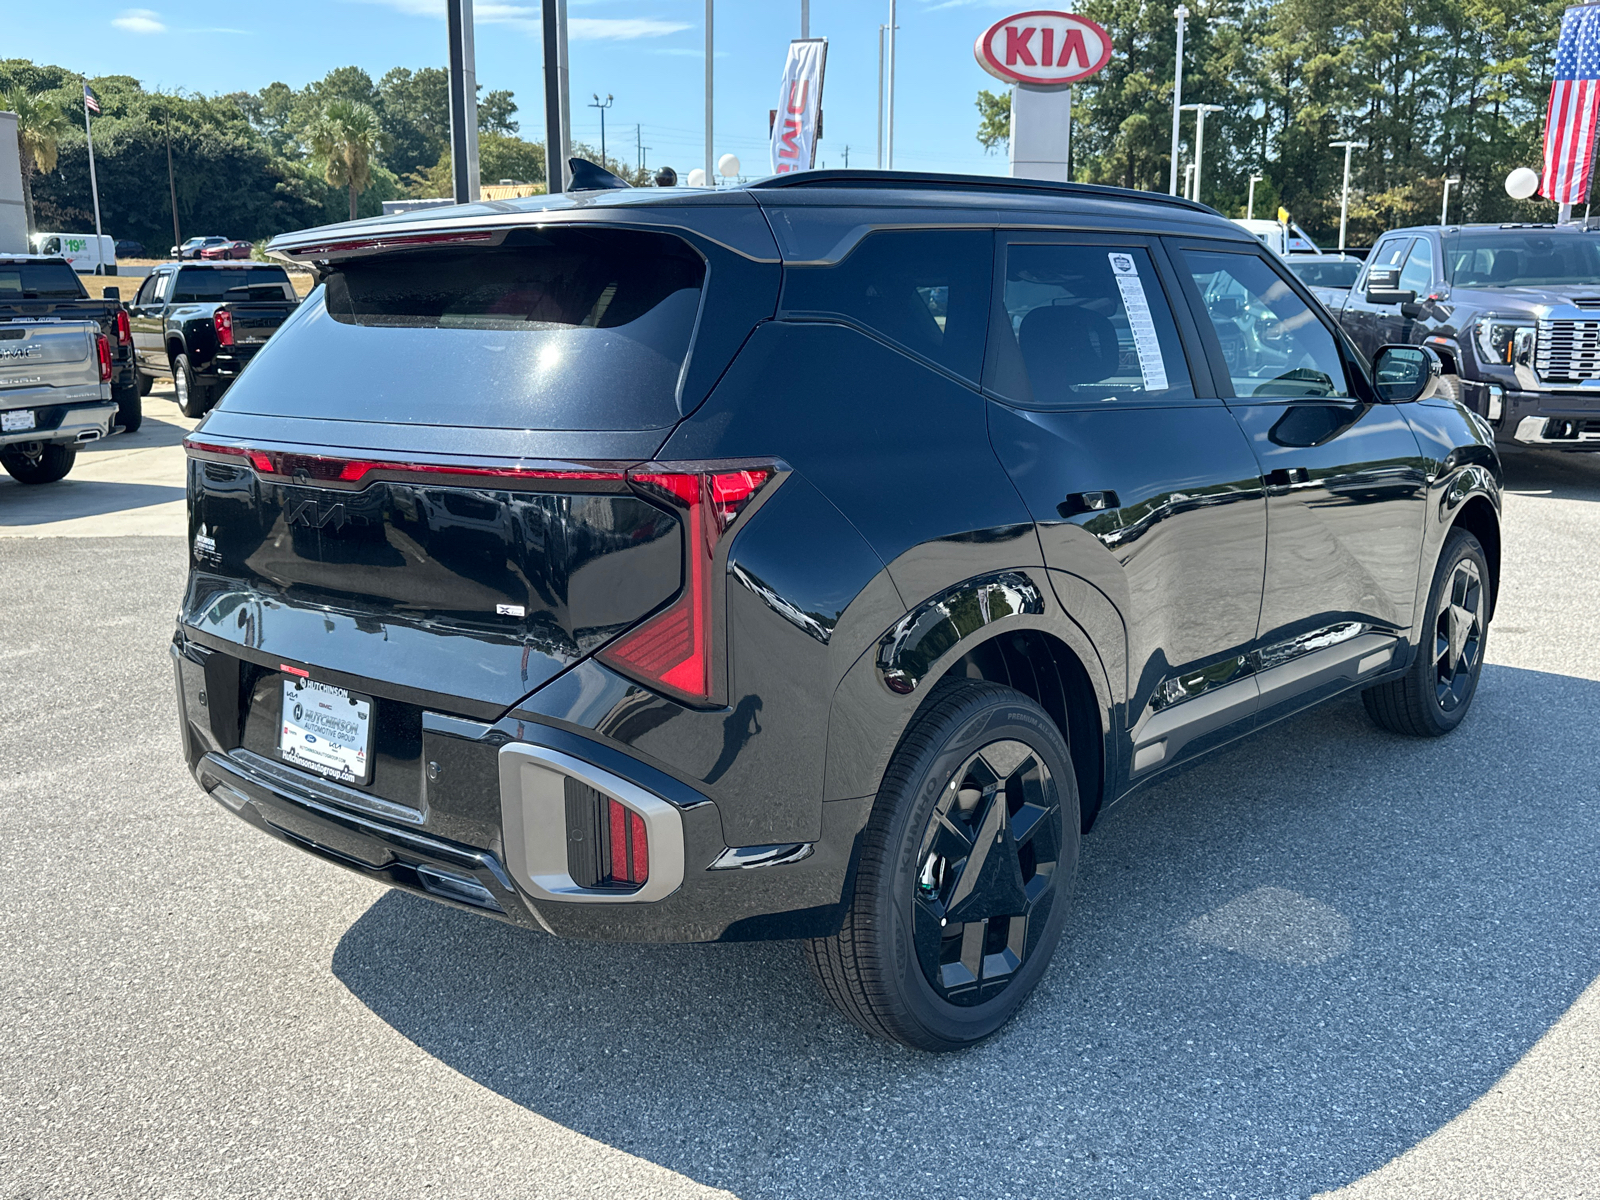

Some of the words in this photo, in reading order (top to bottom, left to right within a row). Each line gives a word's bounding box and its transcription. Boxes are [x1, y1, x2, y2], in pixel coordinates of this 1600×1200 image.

[1005, 27, 1090, 68] KIA
[0, 345, 42, 360] MC
[283, 498, 345, 533] KIA
[307, 679, 349, 699] HUTCHINSON
[318, 702, 333, 711] GMC
[303, 708, 359, 736] HUTCHINSON
[304, 722, 336, 738] AUTOMOTIVE
[337, 732, 356, 743] GROUP
[1007, 713, 1038, 727] PREMIUM
[1038, 723, 1067, 764] ALL-SEASON
[899, 777, 938, 874] KUMHO
